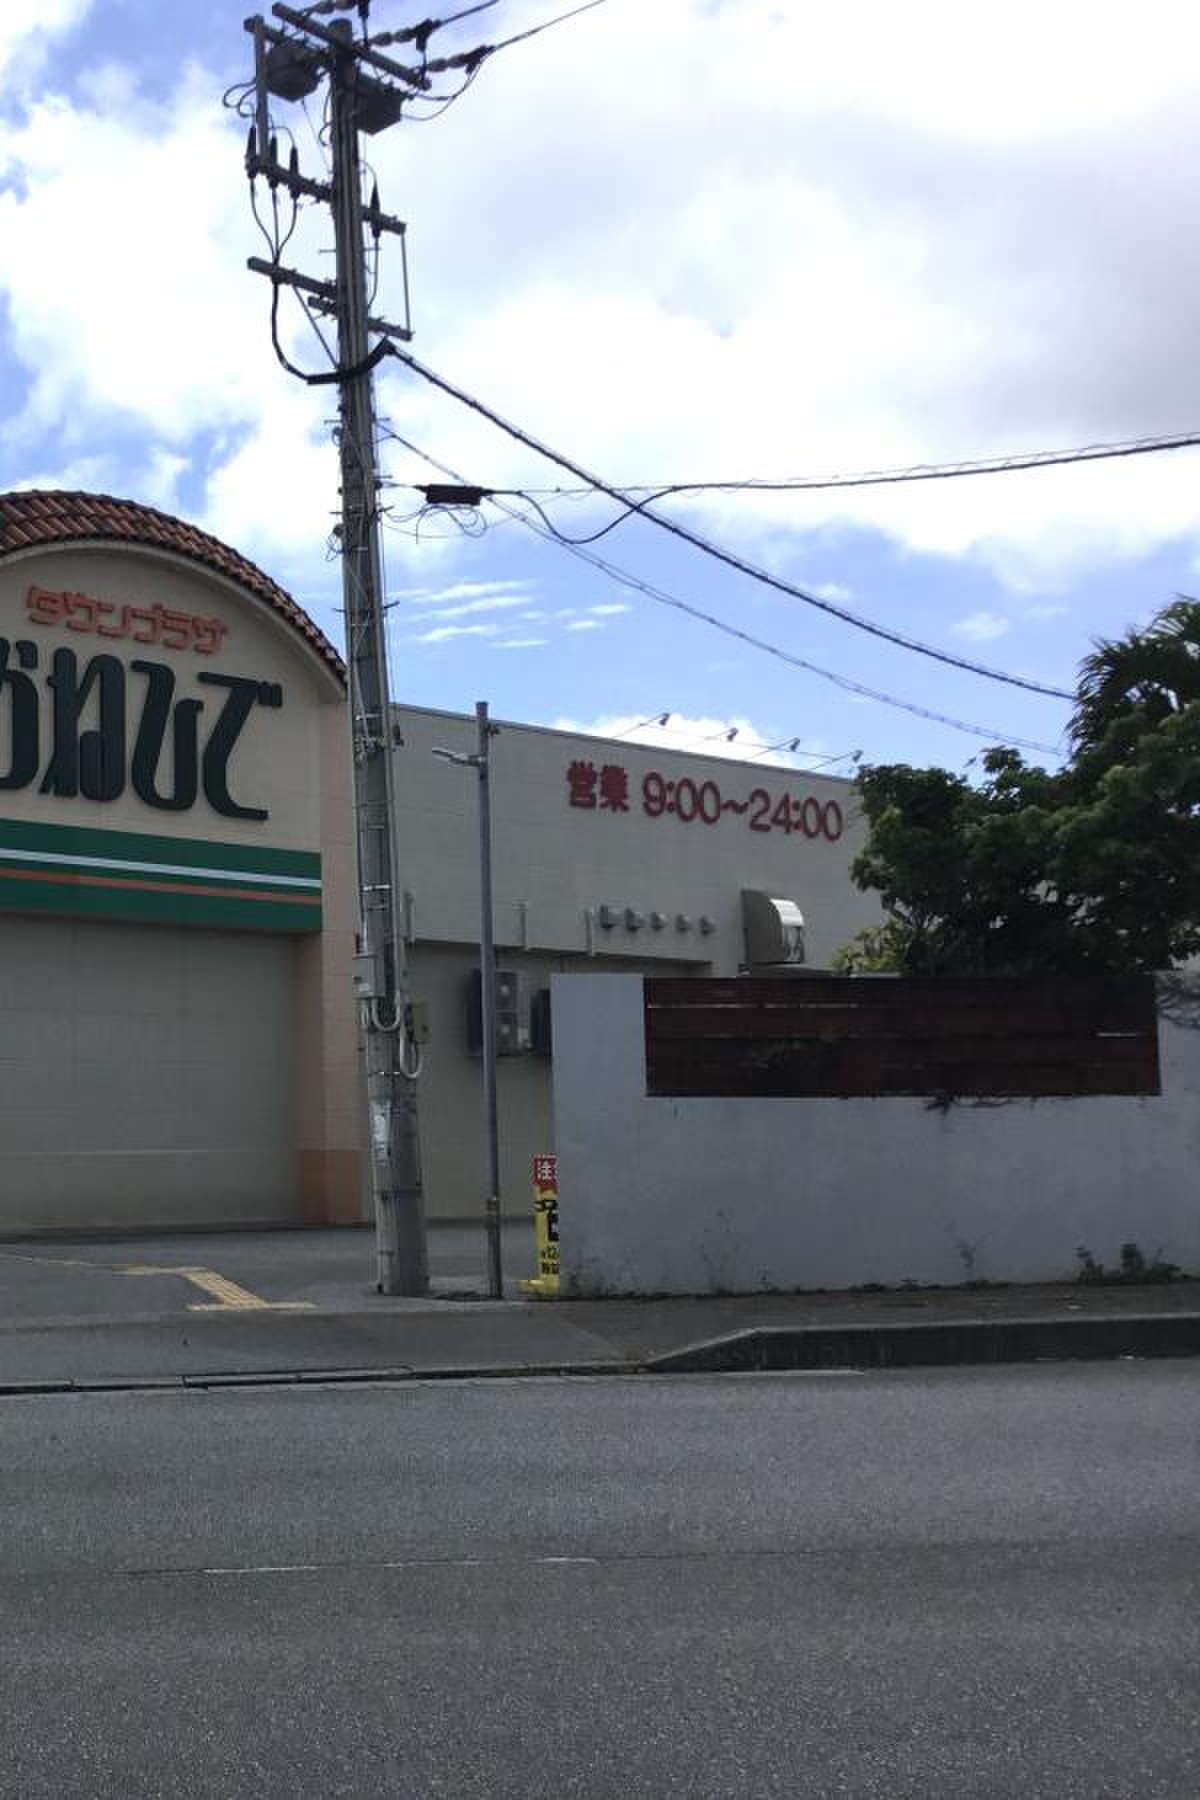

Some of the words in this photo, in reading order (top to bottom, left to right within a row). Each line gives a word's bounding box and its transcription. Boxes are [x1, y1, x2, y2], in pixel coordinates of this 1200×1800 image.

[27, 585, 228, 655] タウンプラザ
[566, 760, 631, 813] 営業
